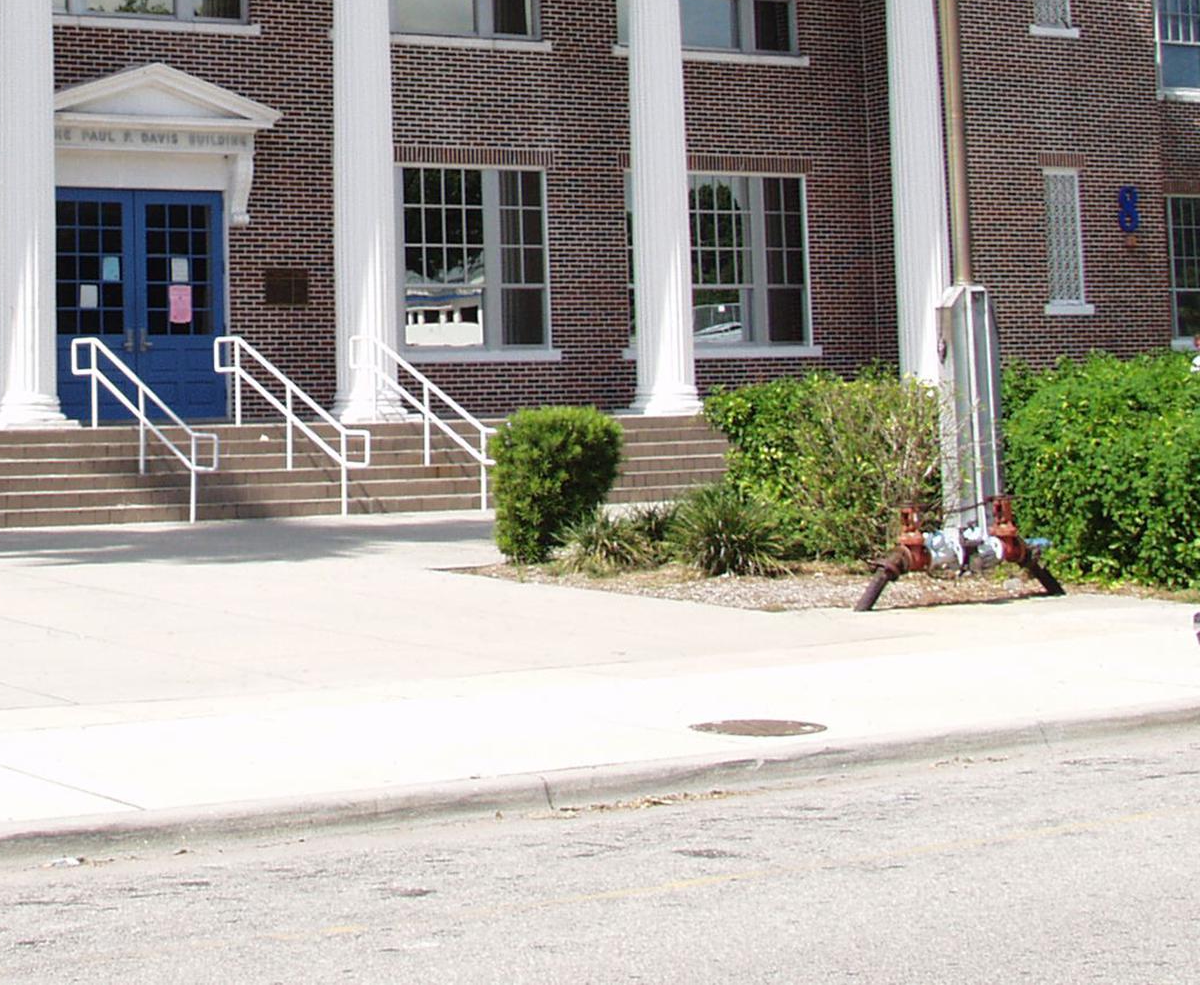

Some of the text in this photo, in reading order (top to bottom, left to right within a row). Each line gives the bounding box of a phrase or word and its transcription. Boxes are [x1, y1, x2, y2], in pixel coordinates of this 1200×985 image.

[54, 128, 72, 141] HE
[81, 130, 115, 143] PAUL
[141, 132, 179, 145] DAVIS
[188, 134, 248, 148] BUILDING
[1119, 186, 1139, 233] 8
